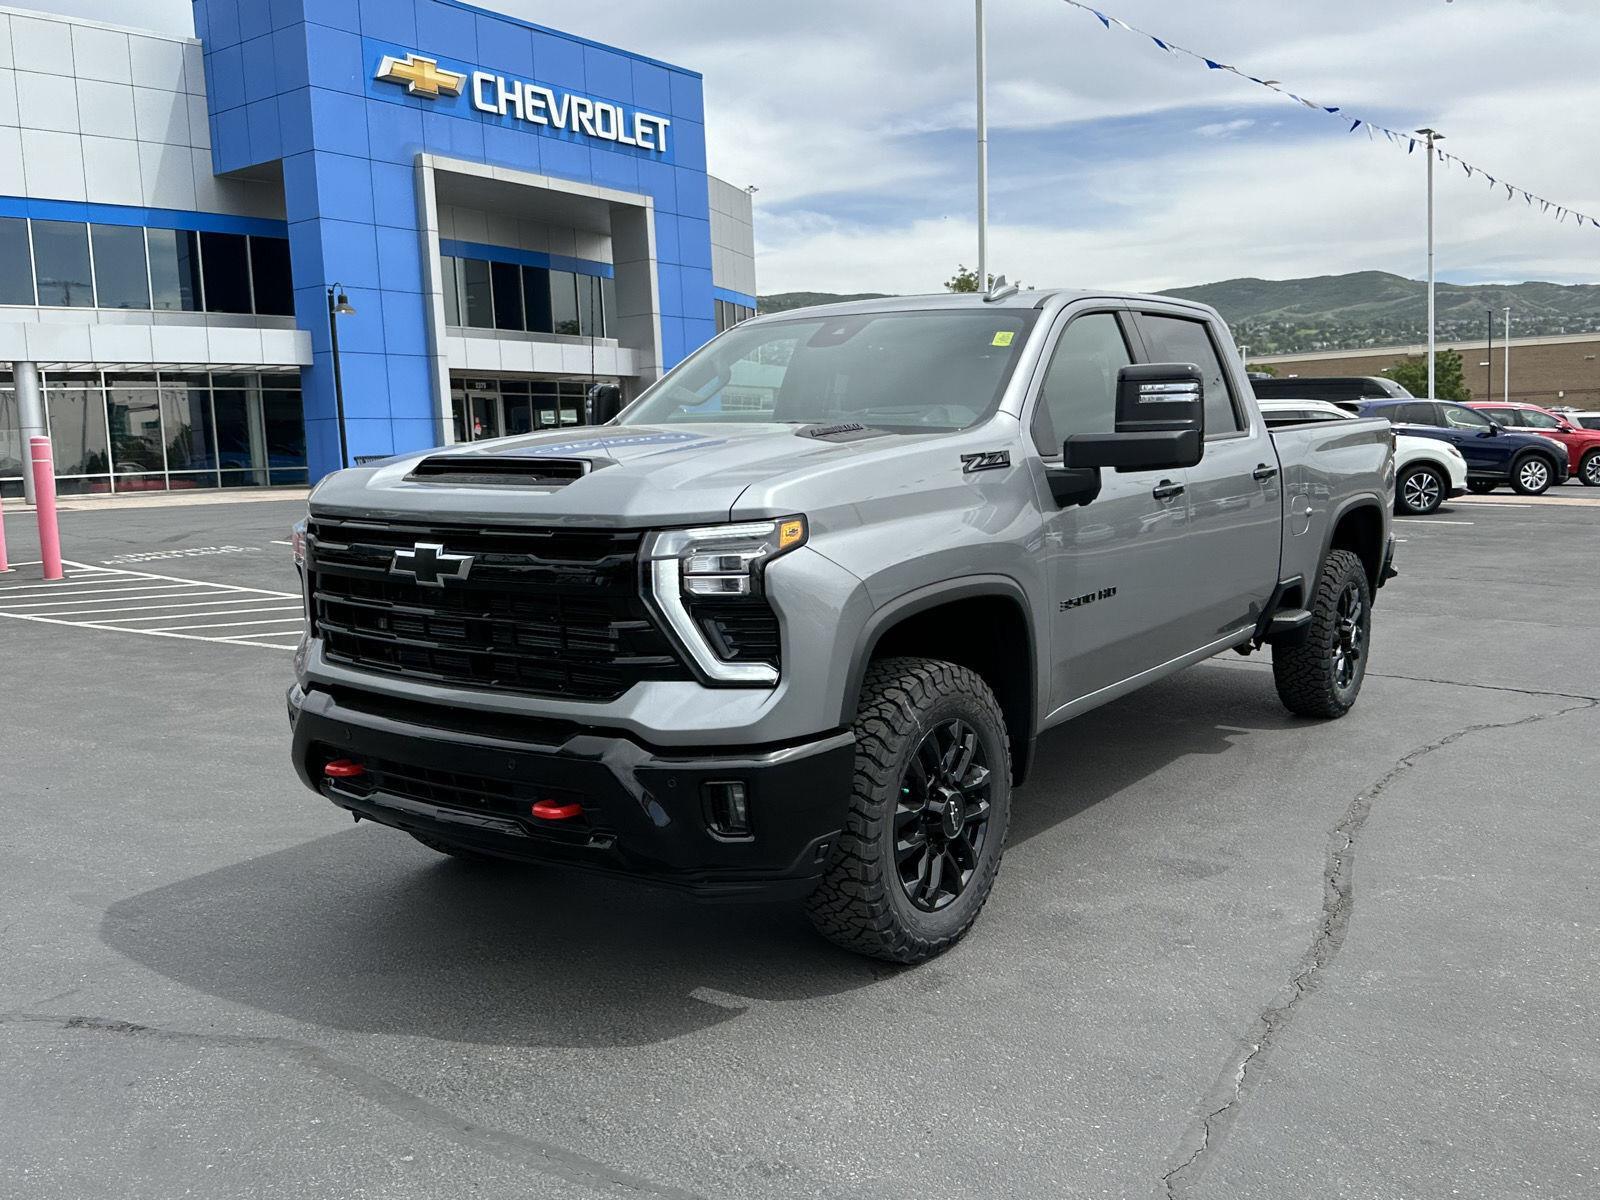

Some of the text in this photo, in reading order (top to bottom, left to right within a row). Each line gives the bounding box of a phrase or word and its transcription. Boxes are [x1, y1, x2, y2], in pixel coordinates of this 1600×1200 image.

[471, 70, 671, 152] CHEVROLET
[960, 450, 1010, 474] Z71
[1098, 586, 1117, 600] HD
